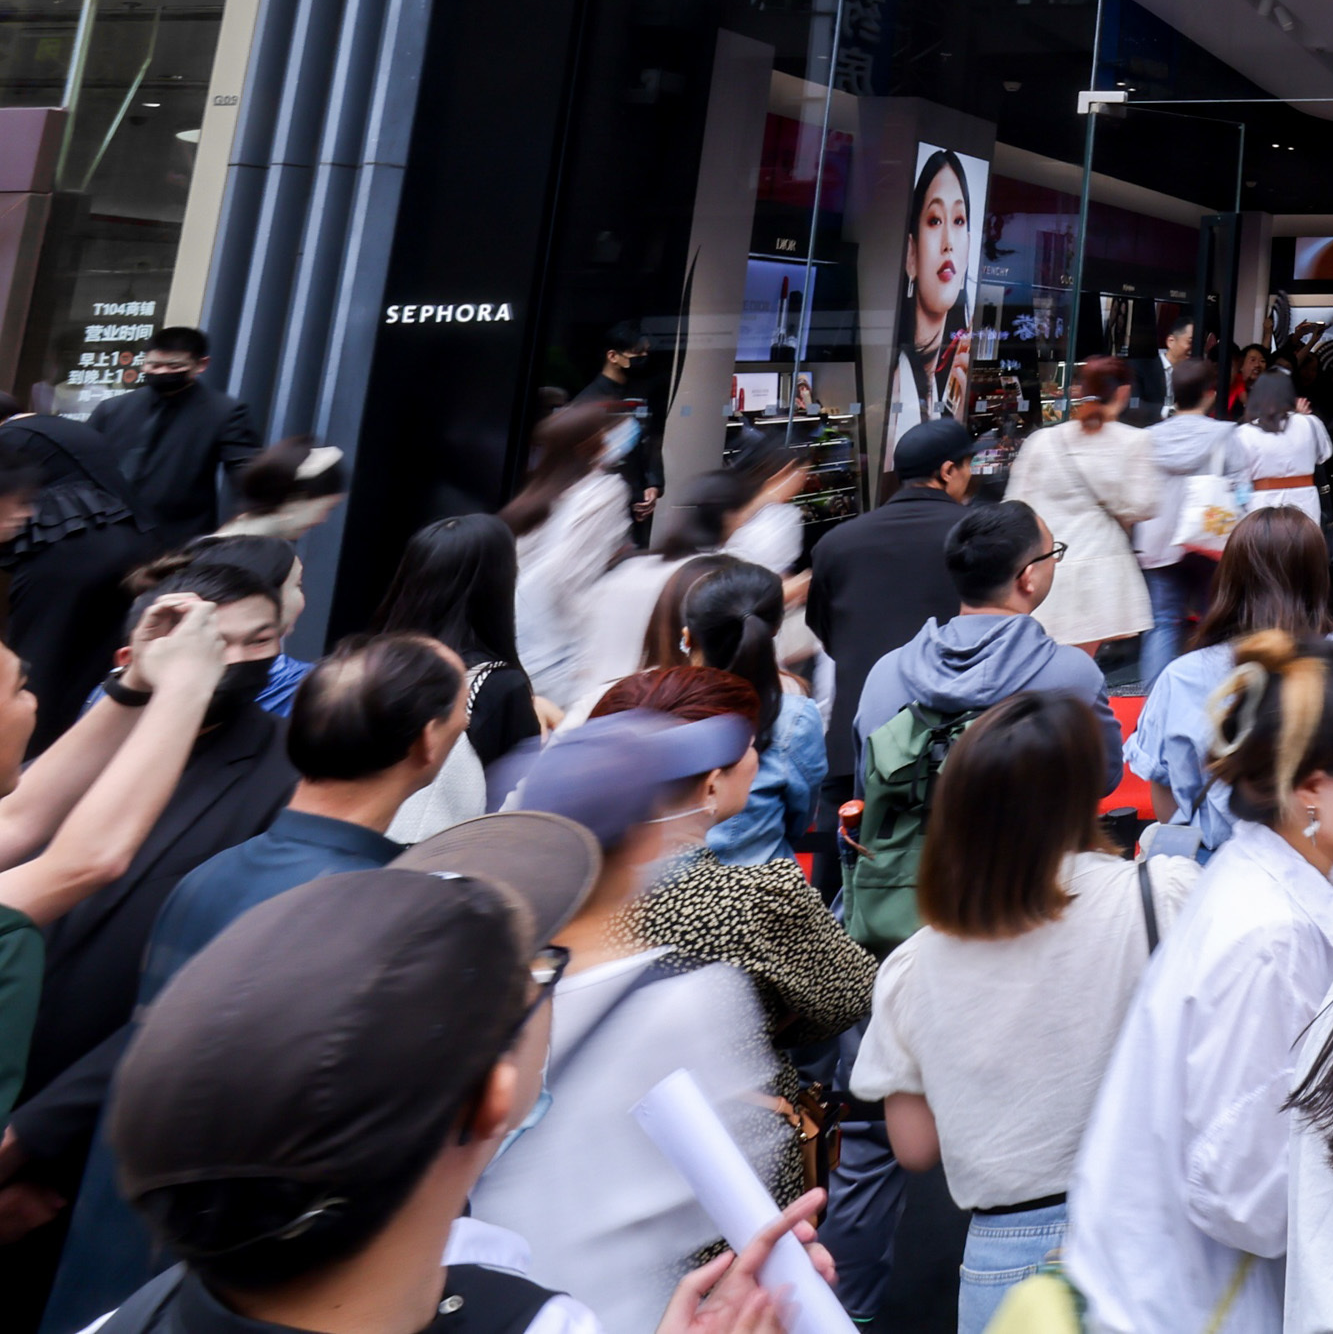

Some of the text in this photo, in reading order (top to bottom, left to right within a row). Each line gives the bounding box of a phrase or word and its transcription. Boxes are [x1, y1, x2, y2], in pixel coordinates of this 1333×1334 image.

[775, 237, 797, 252] DIOR
[385, 303, 513, 324] SEPHORA
[84, 324, 154, 342] 营业时间
